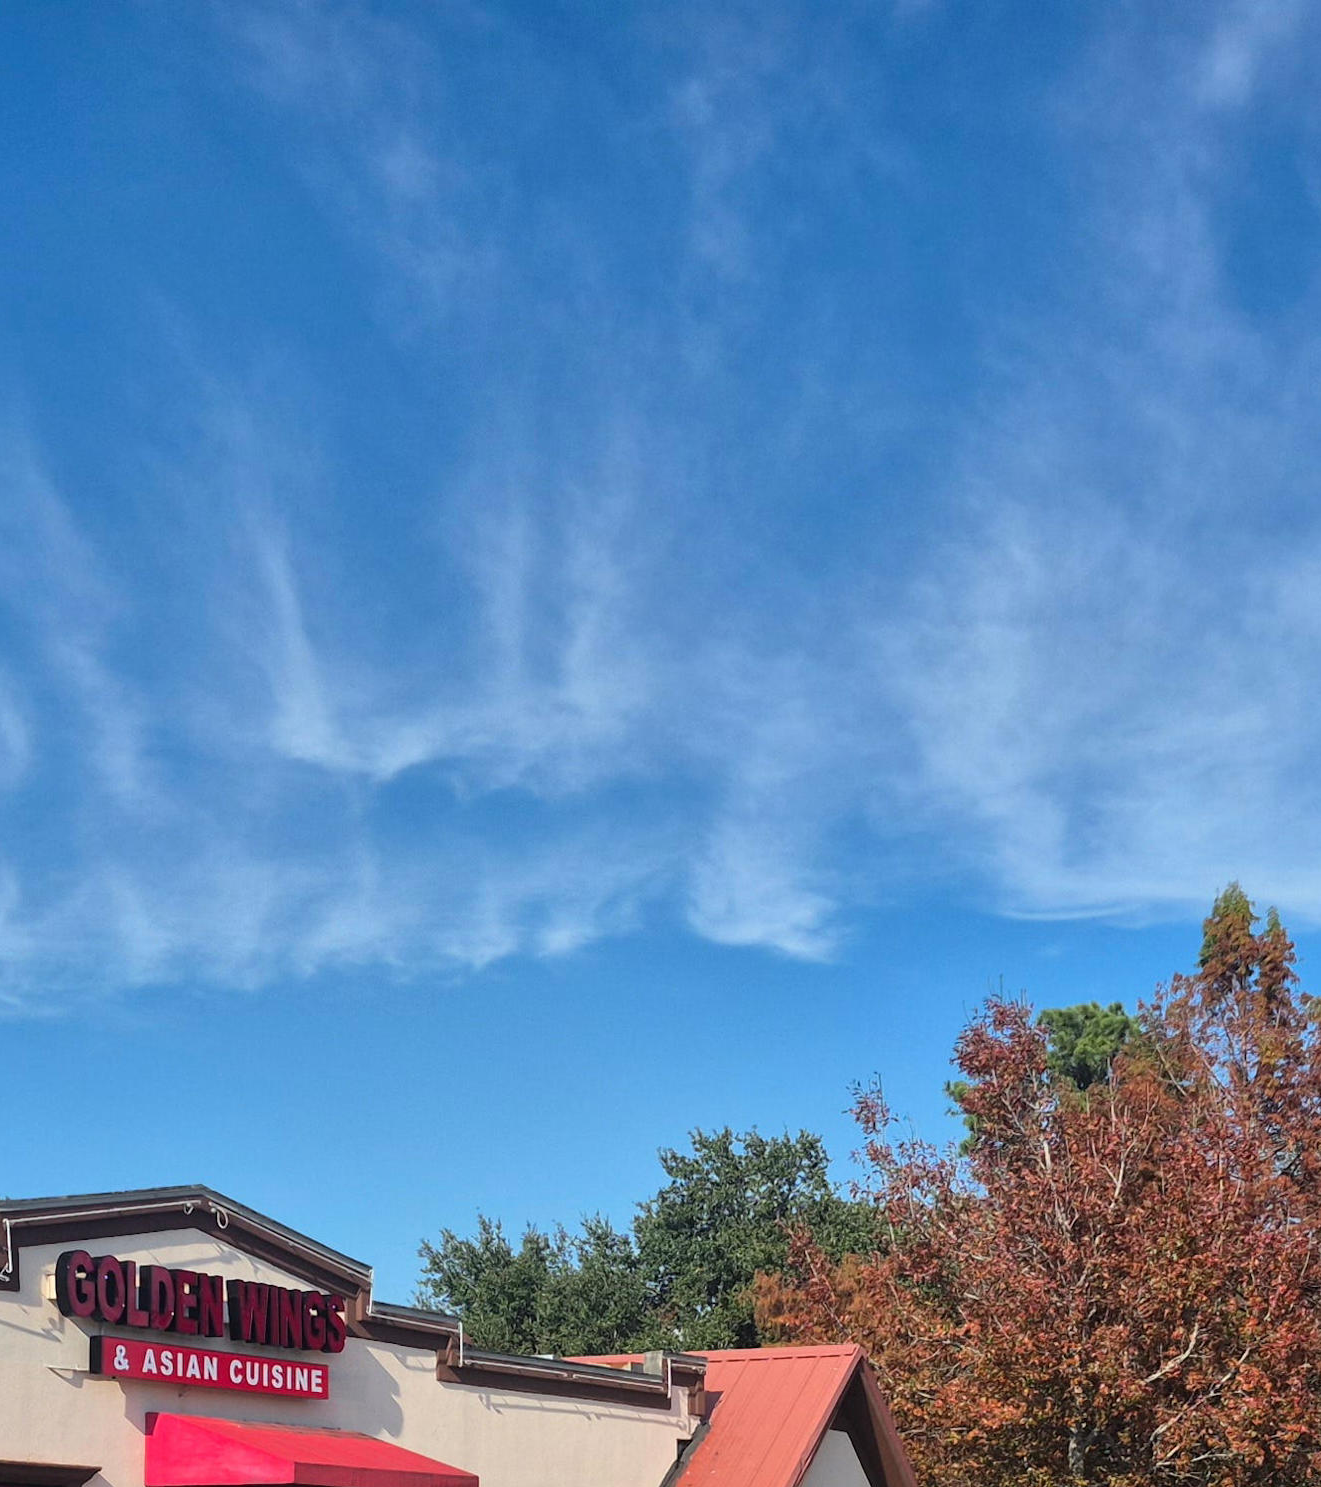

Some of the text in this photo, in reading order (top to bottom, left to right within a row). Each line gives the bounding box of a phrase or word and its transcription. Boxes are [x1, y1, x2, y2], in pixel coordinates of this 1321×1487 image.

[57, 1250, 347, 1353] GOLDEN WINGS
[113, 1345, 324, 1394] & ASIAN CUISINE
